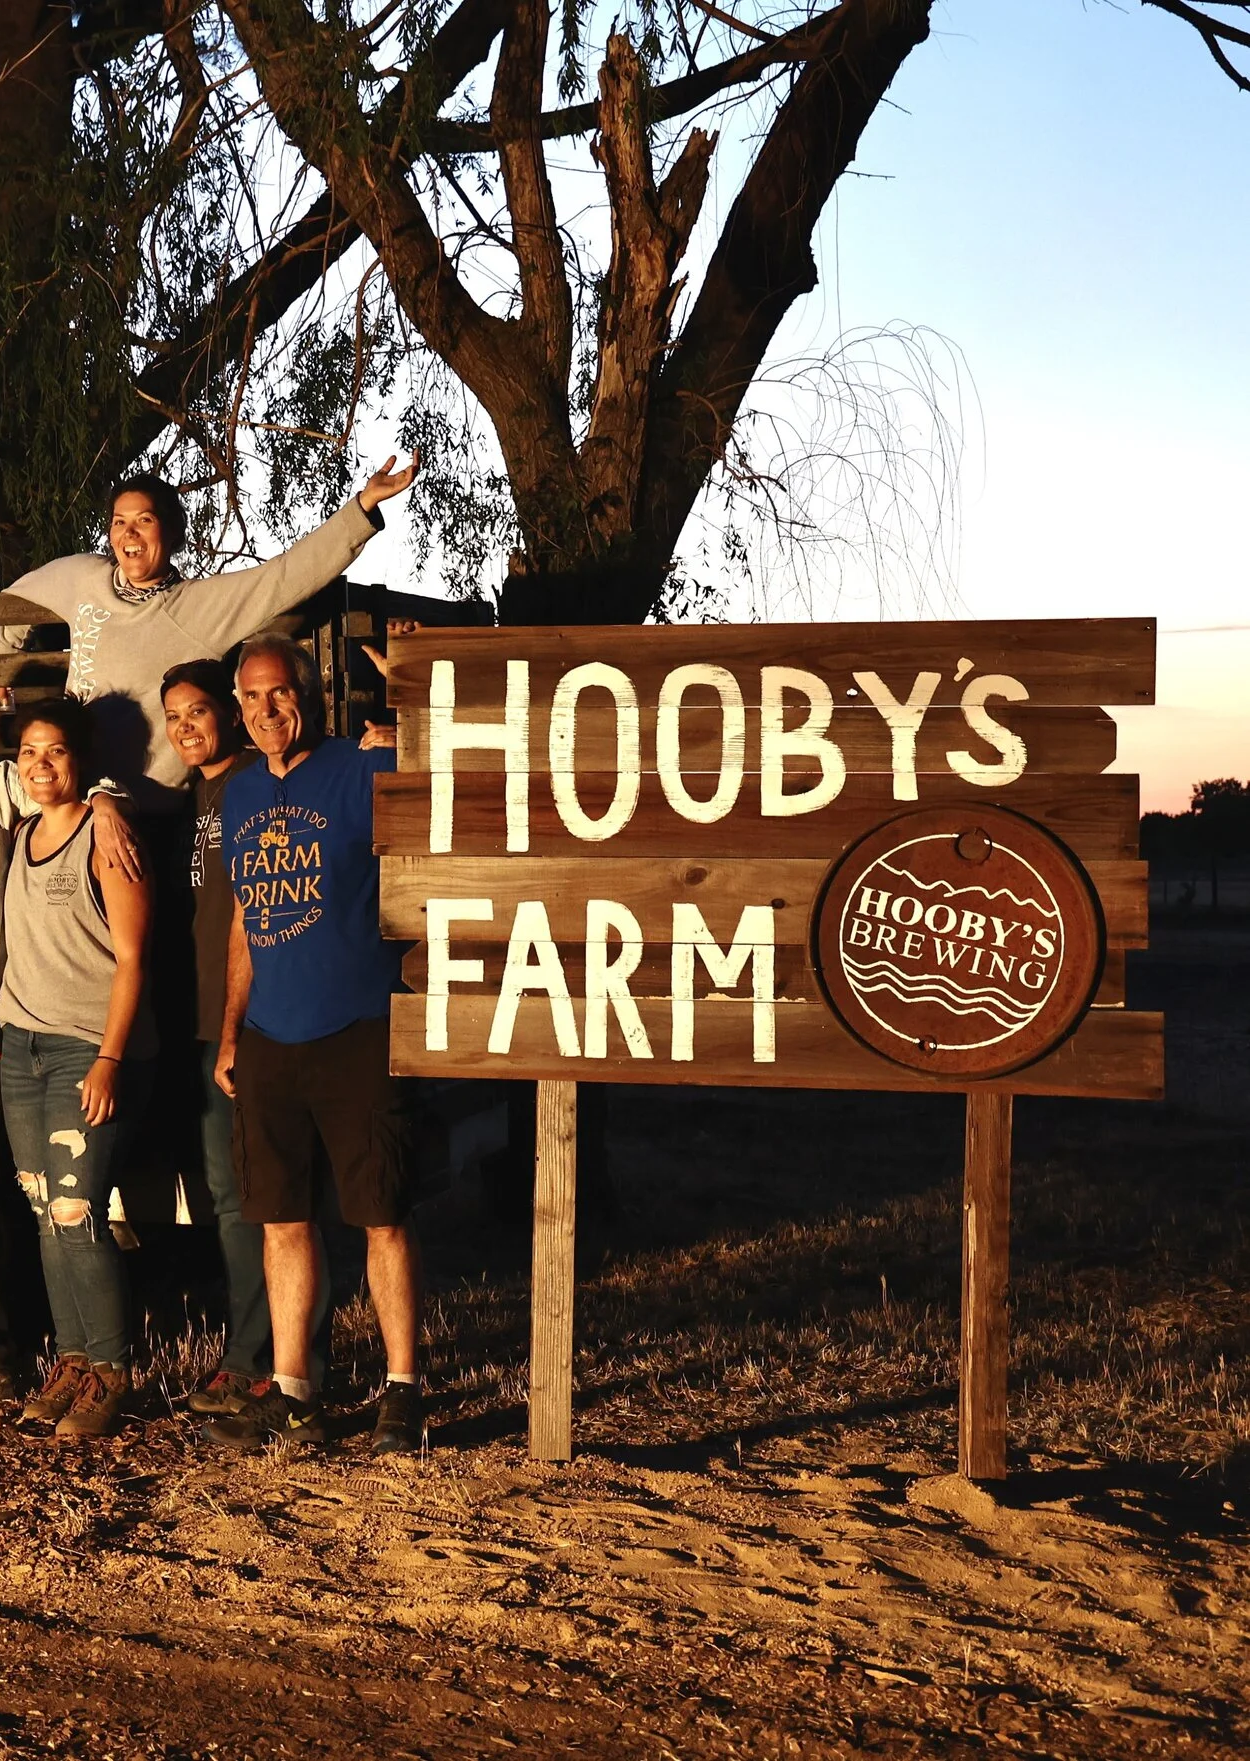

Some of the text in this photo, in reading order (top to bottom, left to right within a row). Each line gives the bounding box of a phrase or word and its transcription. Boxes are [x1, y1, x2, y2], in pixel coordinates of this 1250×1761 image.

[428, 657, 1030, 854] HOOBY'S
[233, 810, 266, 845] THAT'S
[268, 805, 304, 820] WHAT
[304, 808, 309, 820] I
[309, 811, 328, 830] DO
[231, 841, 322, 881] I FARM
[241, 875, 323, 909] DRINK
[279, 905, 323, 943] THINGS
[855, 886, 1058, 958] HOOBY'S
[425, 898, 776, 1064] FARM
[847, 917, 1048, 989] BREWING
